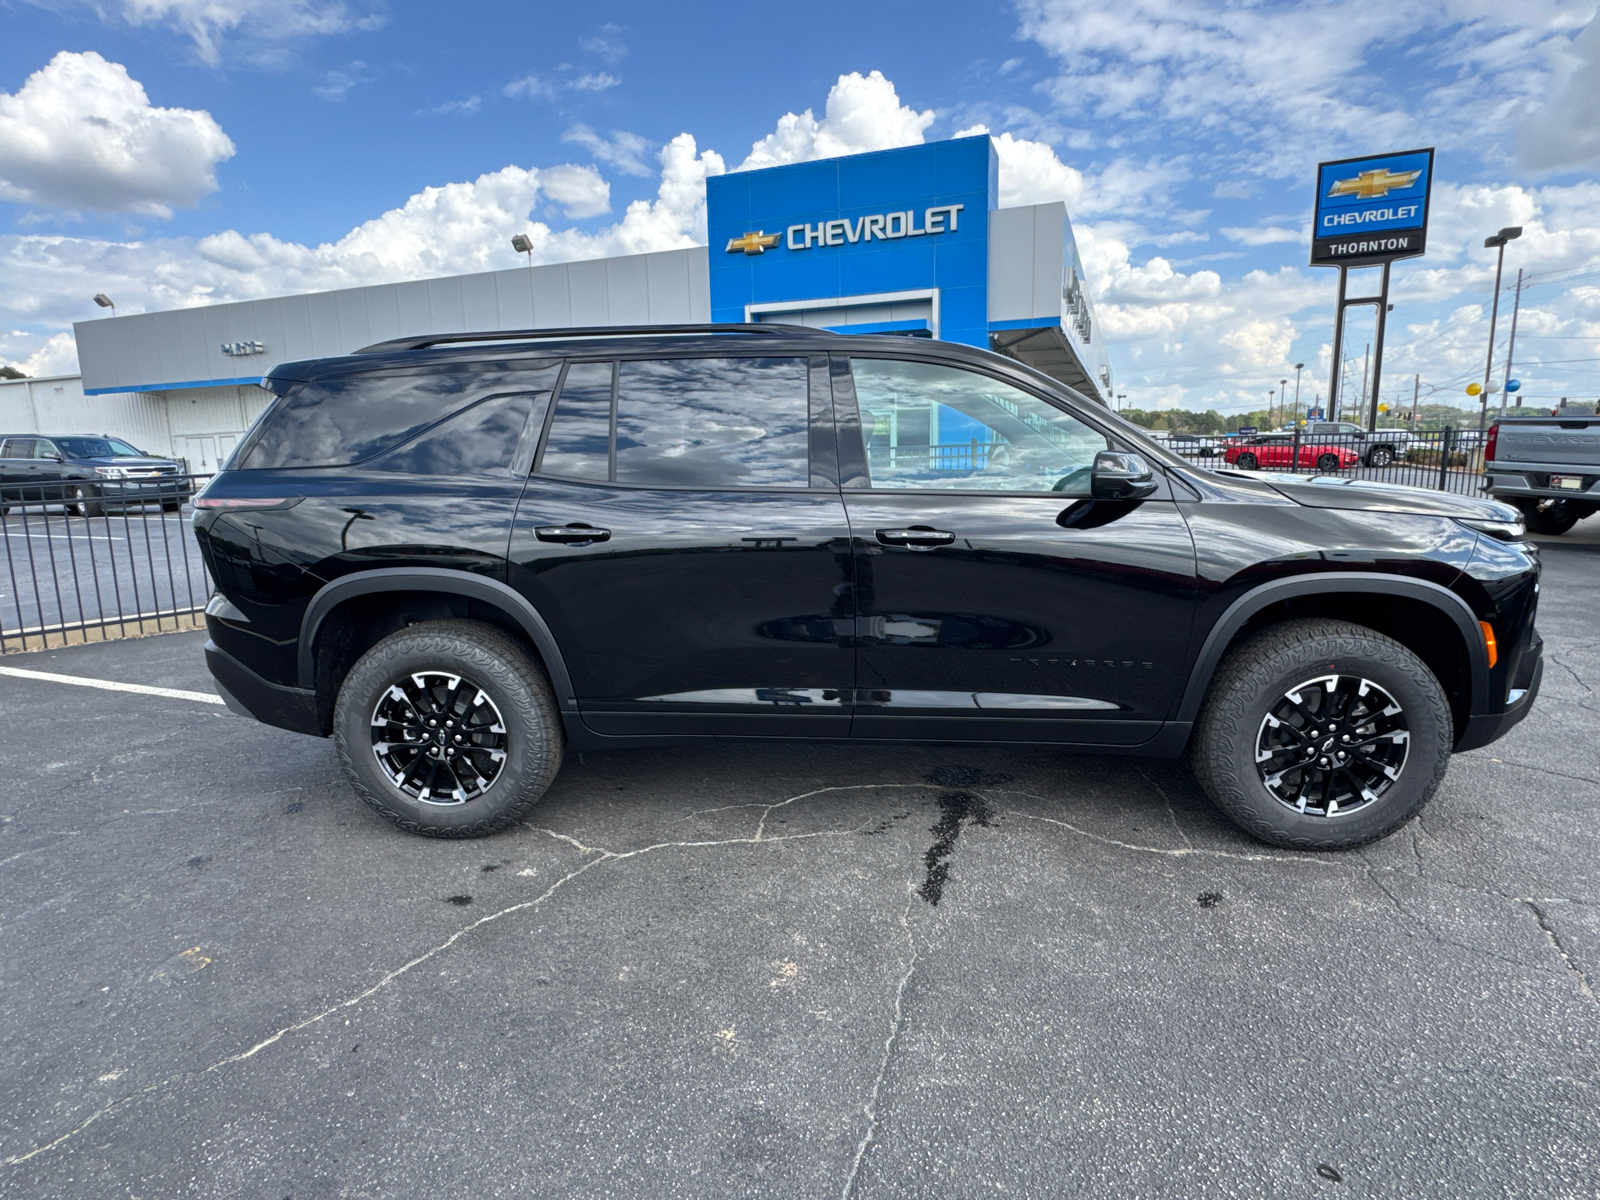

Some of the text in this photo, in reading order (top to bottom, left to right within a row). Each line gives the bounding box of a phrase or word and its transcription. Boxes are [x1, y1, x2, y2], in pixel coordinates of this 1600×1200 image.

[1323, 205, 1419, 227] CHEVROLET
[787, 204, 964, 250] CHEVROLET
[1329, 238, 1409, 255] THORNTON
[221, 341, 263, 356] PARTS
[1505, 433, 1600, 445] CHEVRO
